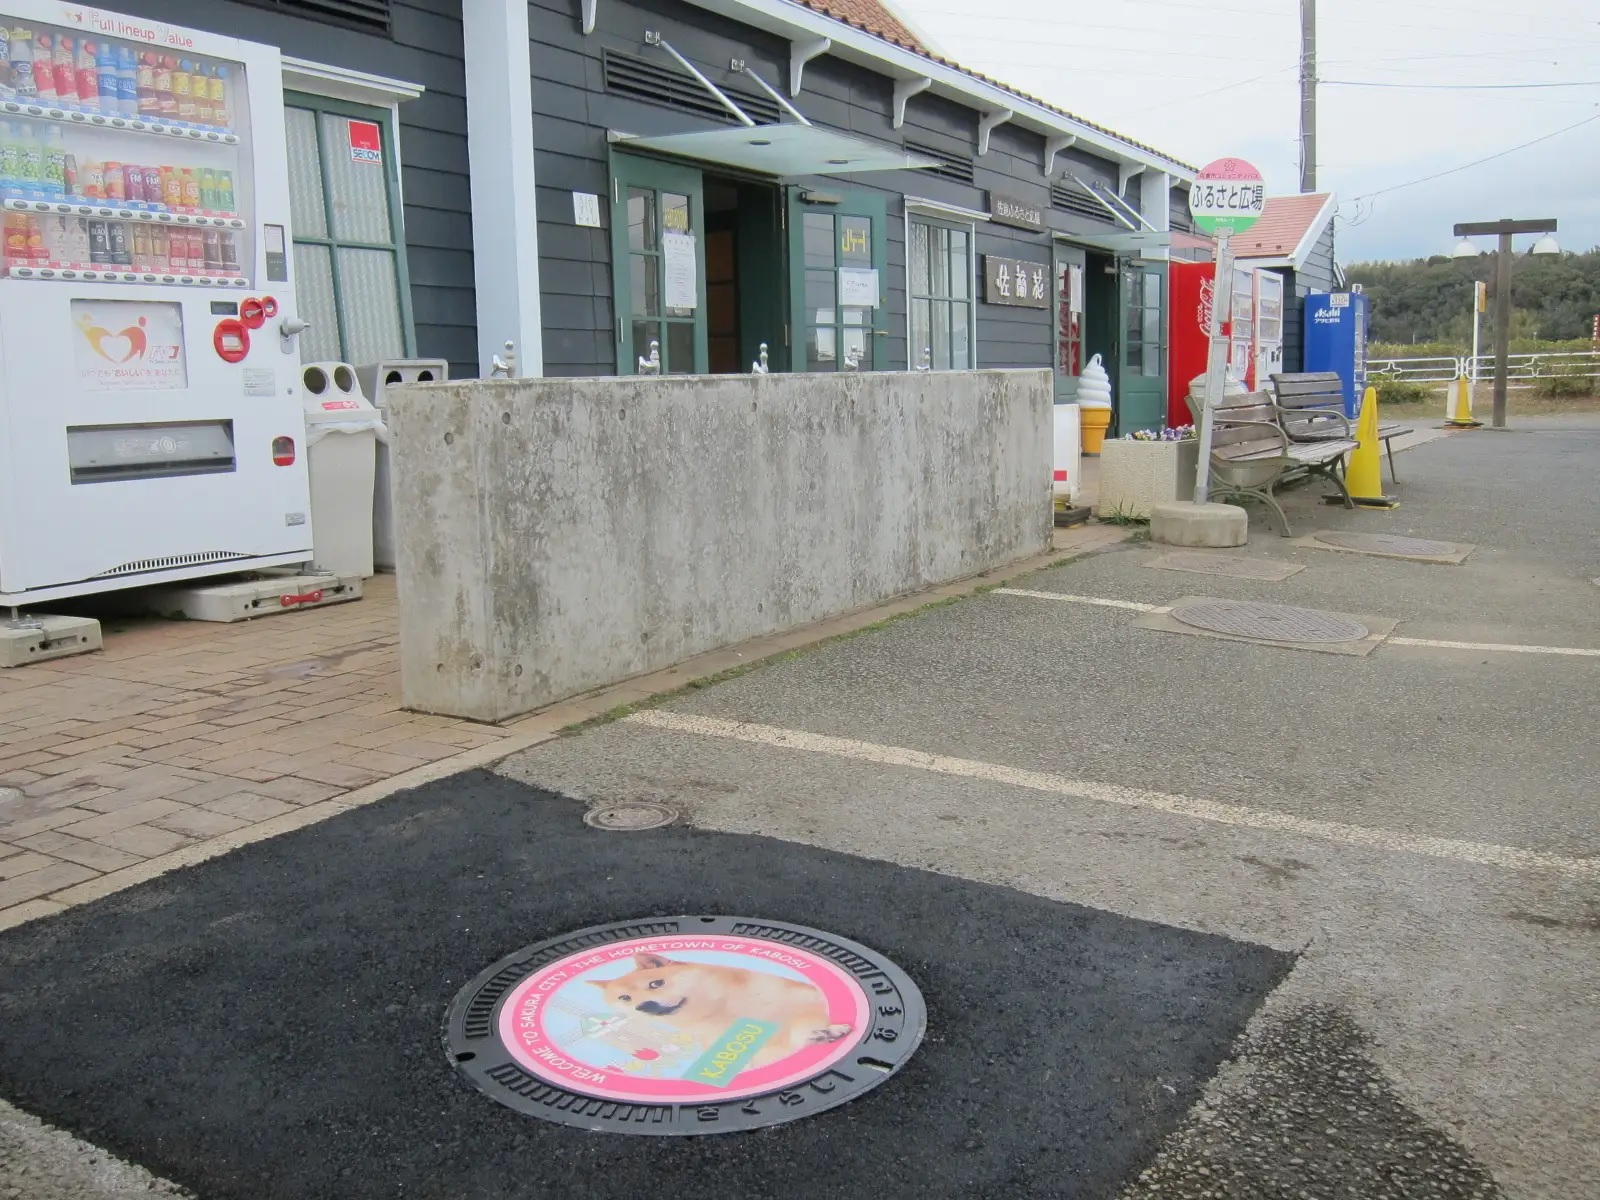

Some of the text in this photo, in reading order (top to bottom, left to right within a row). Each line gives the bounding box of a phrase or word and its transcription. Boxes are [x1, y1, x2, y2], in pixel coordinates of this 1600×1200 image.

[89, 11, 193, 48] Full lineup Value
[352, 149, 380, 160] SECOM
[1192, 184, 1263, 211] ふるさと広場
[1314, 307, 1341, 317] Asahi
[608, 941, 717, 958] HOMETOWN
[722, 943, 746, 952] OF
[572, 956, 606, 970] THE
[750, 947, 813, 969] KABOSU
[520, 993, 542, 1028] SAKURA
[523, 1031, 541, 1046] TO
[700, 1023, 764, 1079] KABOSU
[532, 1046, 607, 1084] WELCOME
